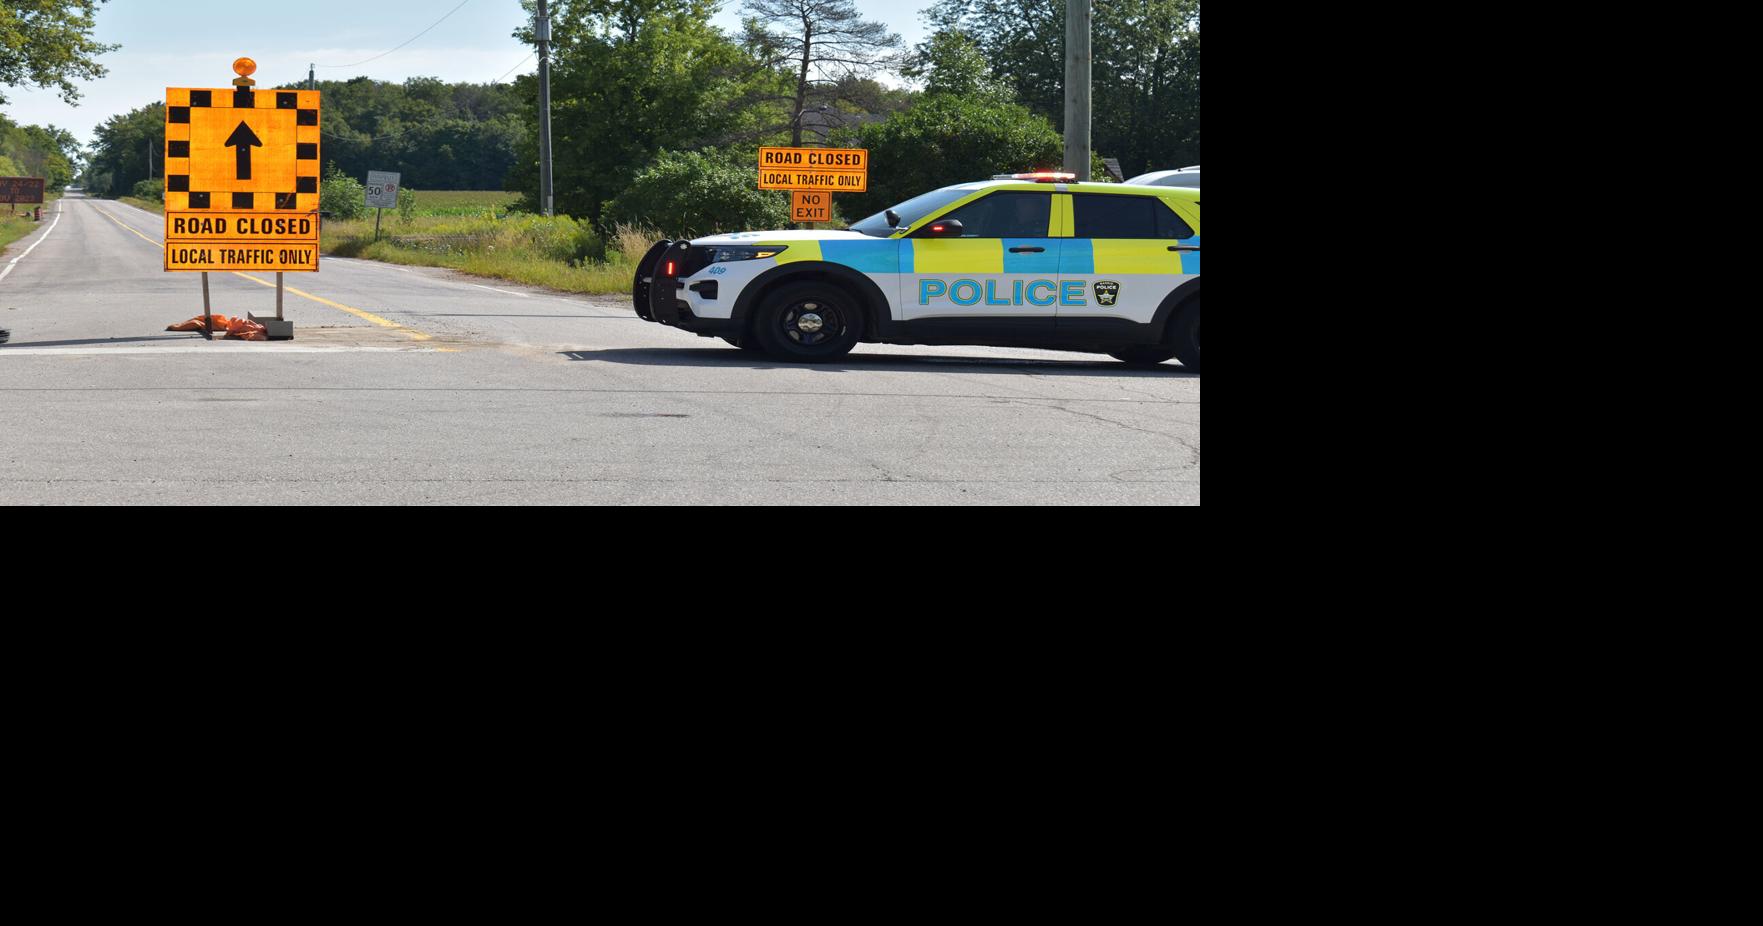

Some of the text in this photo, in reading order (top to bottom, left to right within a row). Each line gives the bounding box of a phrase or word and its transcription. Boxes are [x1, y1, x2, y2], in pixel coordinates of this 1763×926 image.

[765, 152, 861, 166] ROAD CLOSED
[763, 173, 861, 187] LOCAL TRAFFIC ONLY
[368, 187, 381, 196] 50
[802, 194, 821, 205] NO
[796, 208, 825, 218] EXIT
[174, 217, 311, 235] ROAD CLOSED
[171, 249, 312, 265] LOCAL TRAFFIC ONLY
[708, 266, 727, 275] 409
[918, 278, 1088, 307] POLICE
